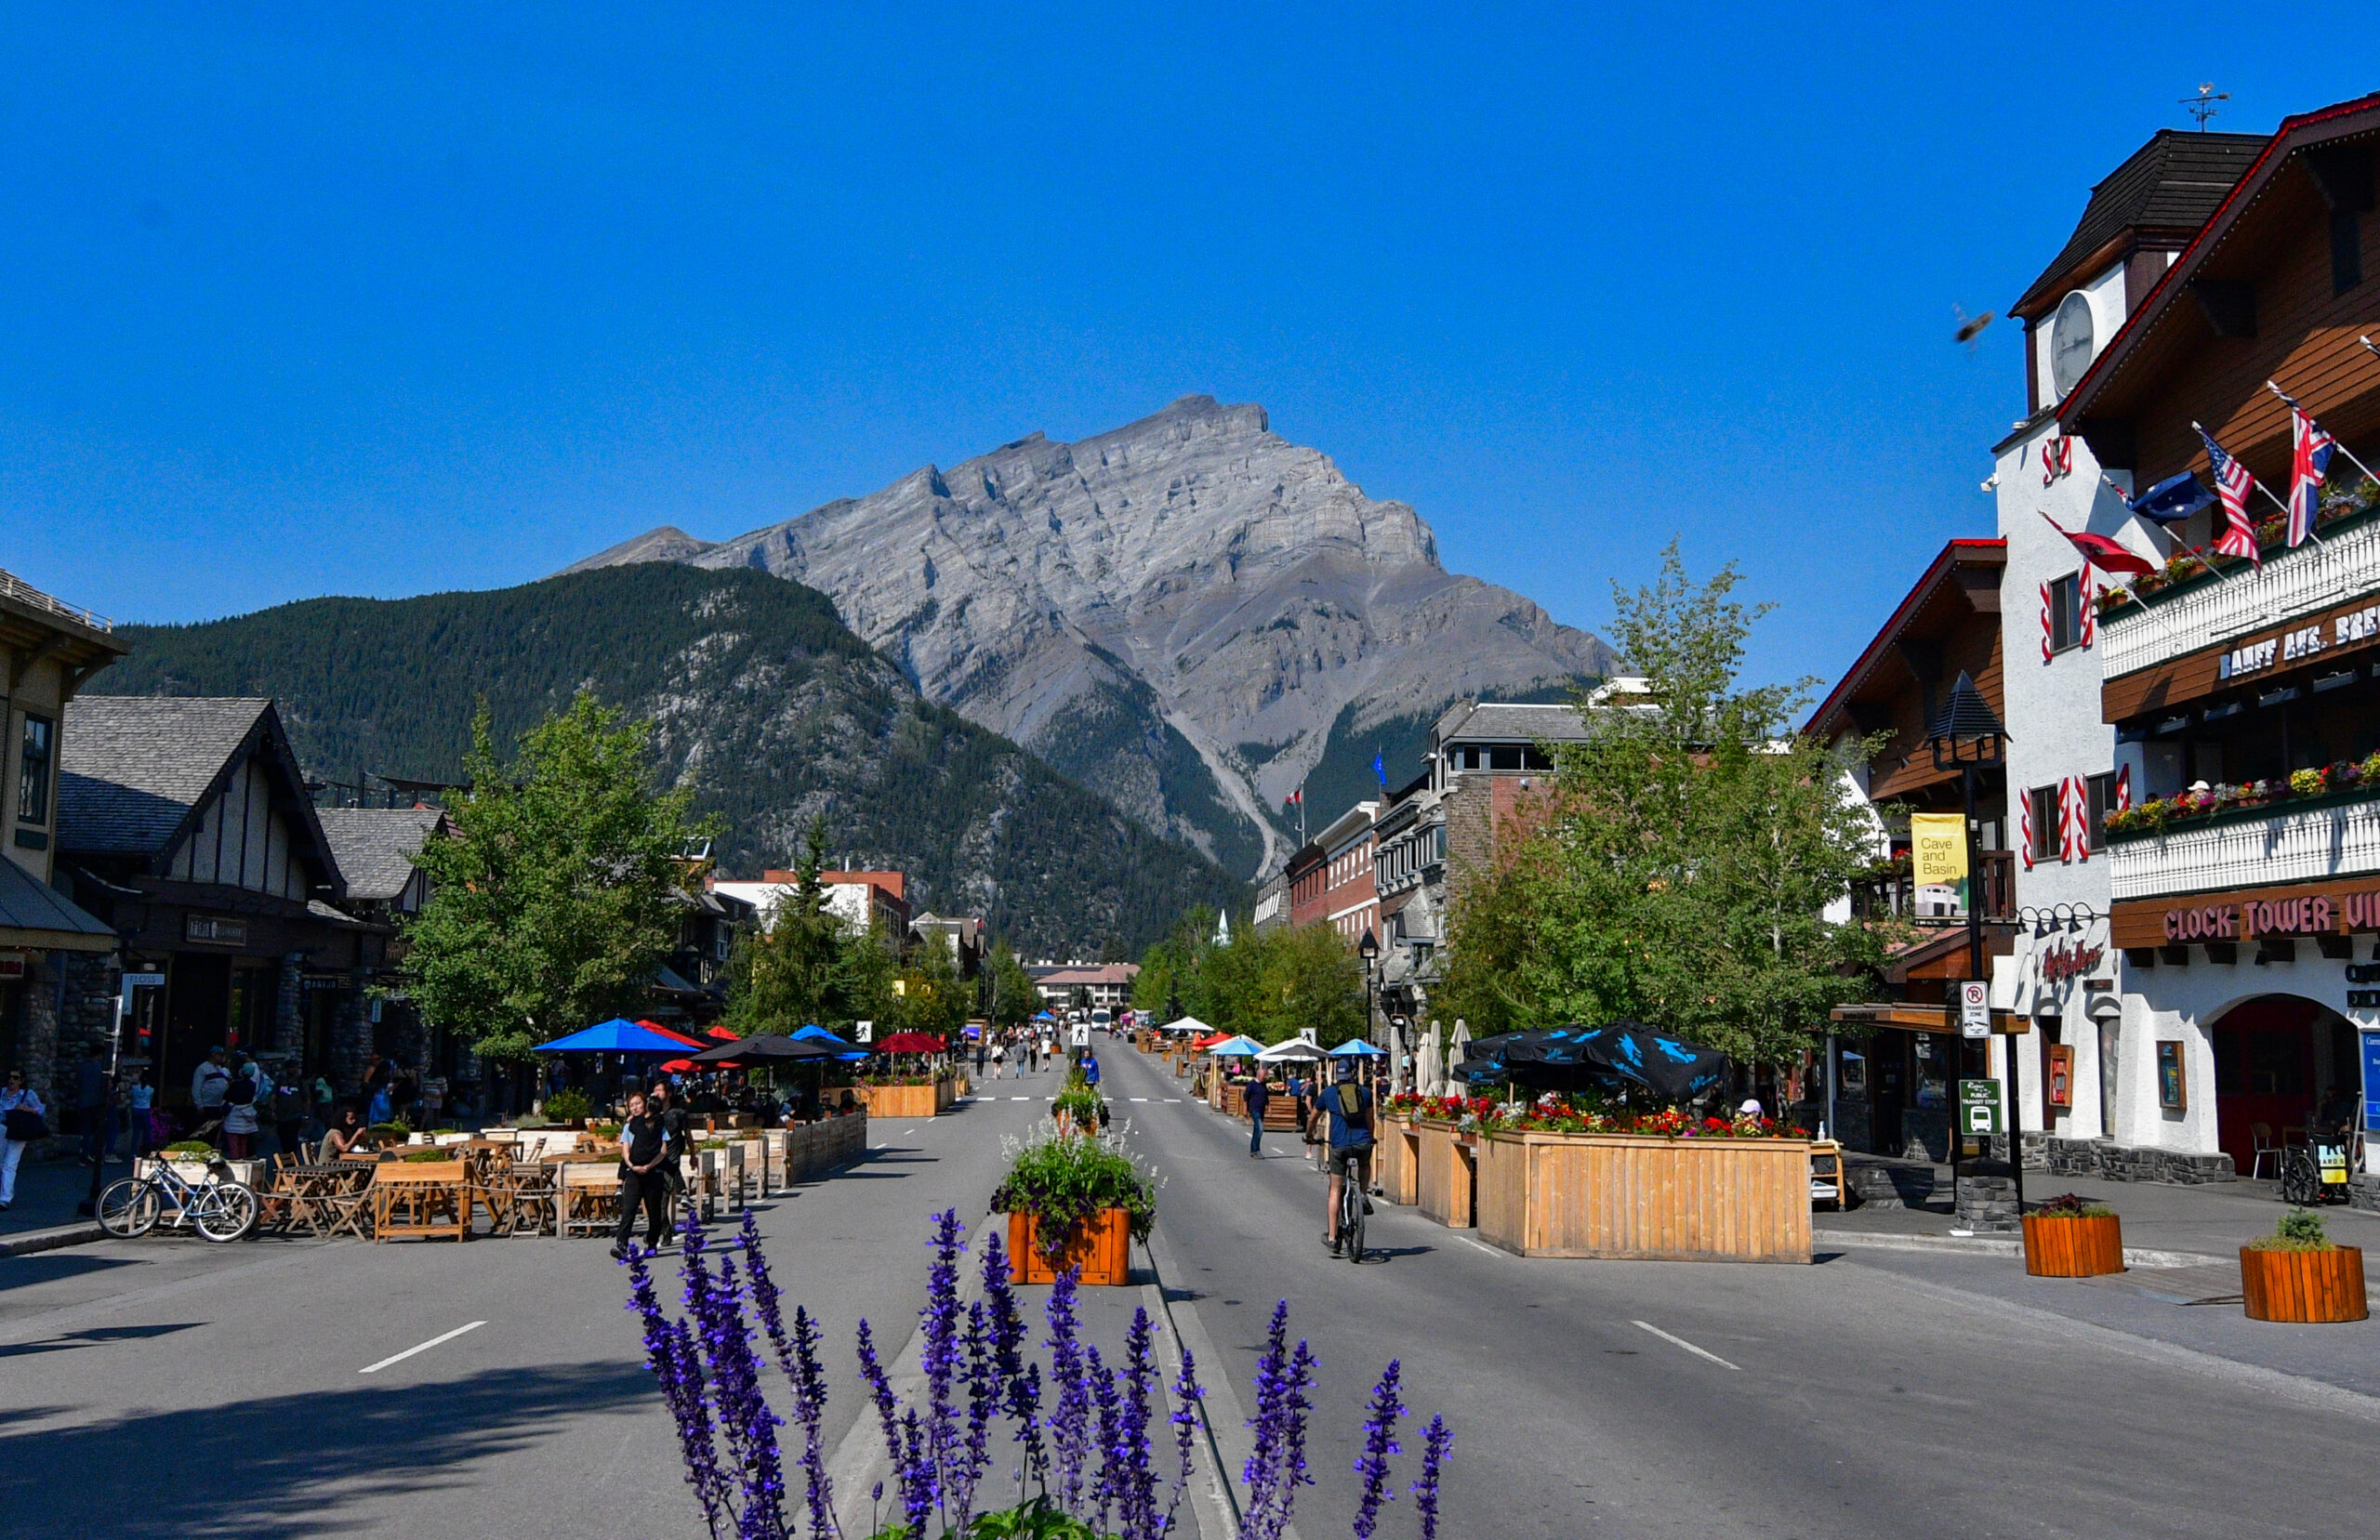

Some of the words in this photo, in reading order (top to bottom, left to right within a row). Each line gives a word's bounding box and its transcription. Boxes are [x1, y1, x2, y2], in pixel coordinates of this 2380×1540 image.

[2220, 638, 2278, 679] BANFF
[2283, 625, 2328, 661] AVE.
[2335, 604, 2380, 645] BRE
[1921, 837, 1953, 849] Cave
[1922, 850, 1946, 862] and
[1923, 862, 1957, 875] Basin
[2163, 905, 2232, 941] CLOCK
[2243, 896, 2331, 936] TOWER
